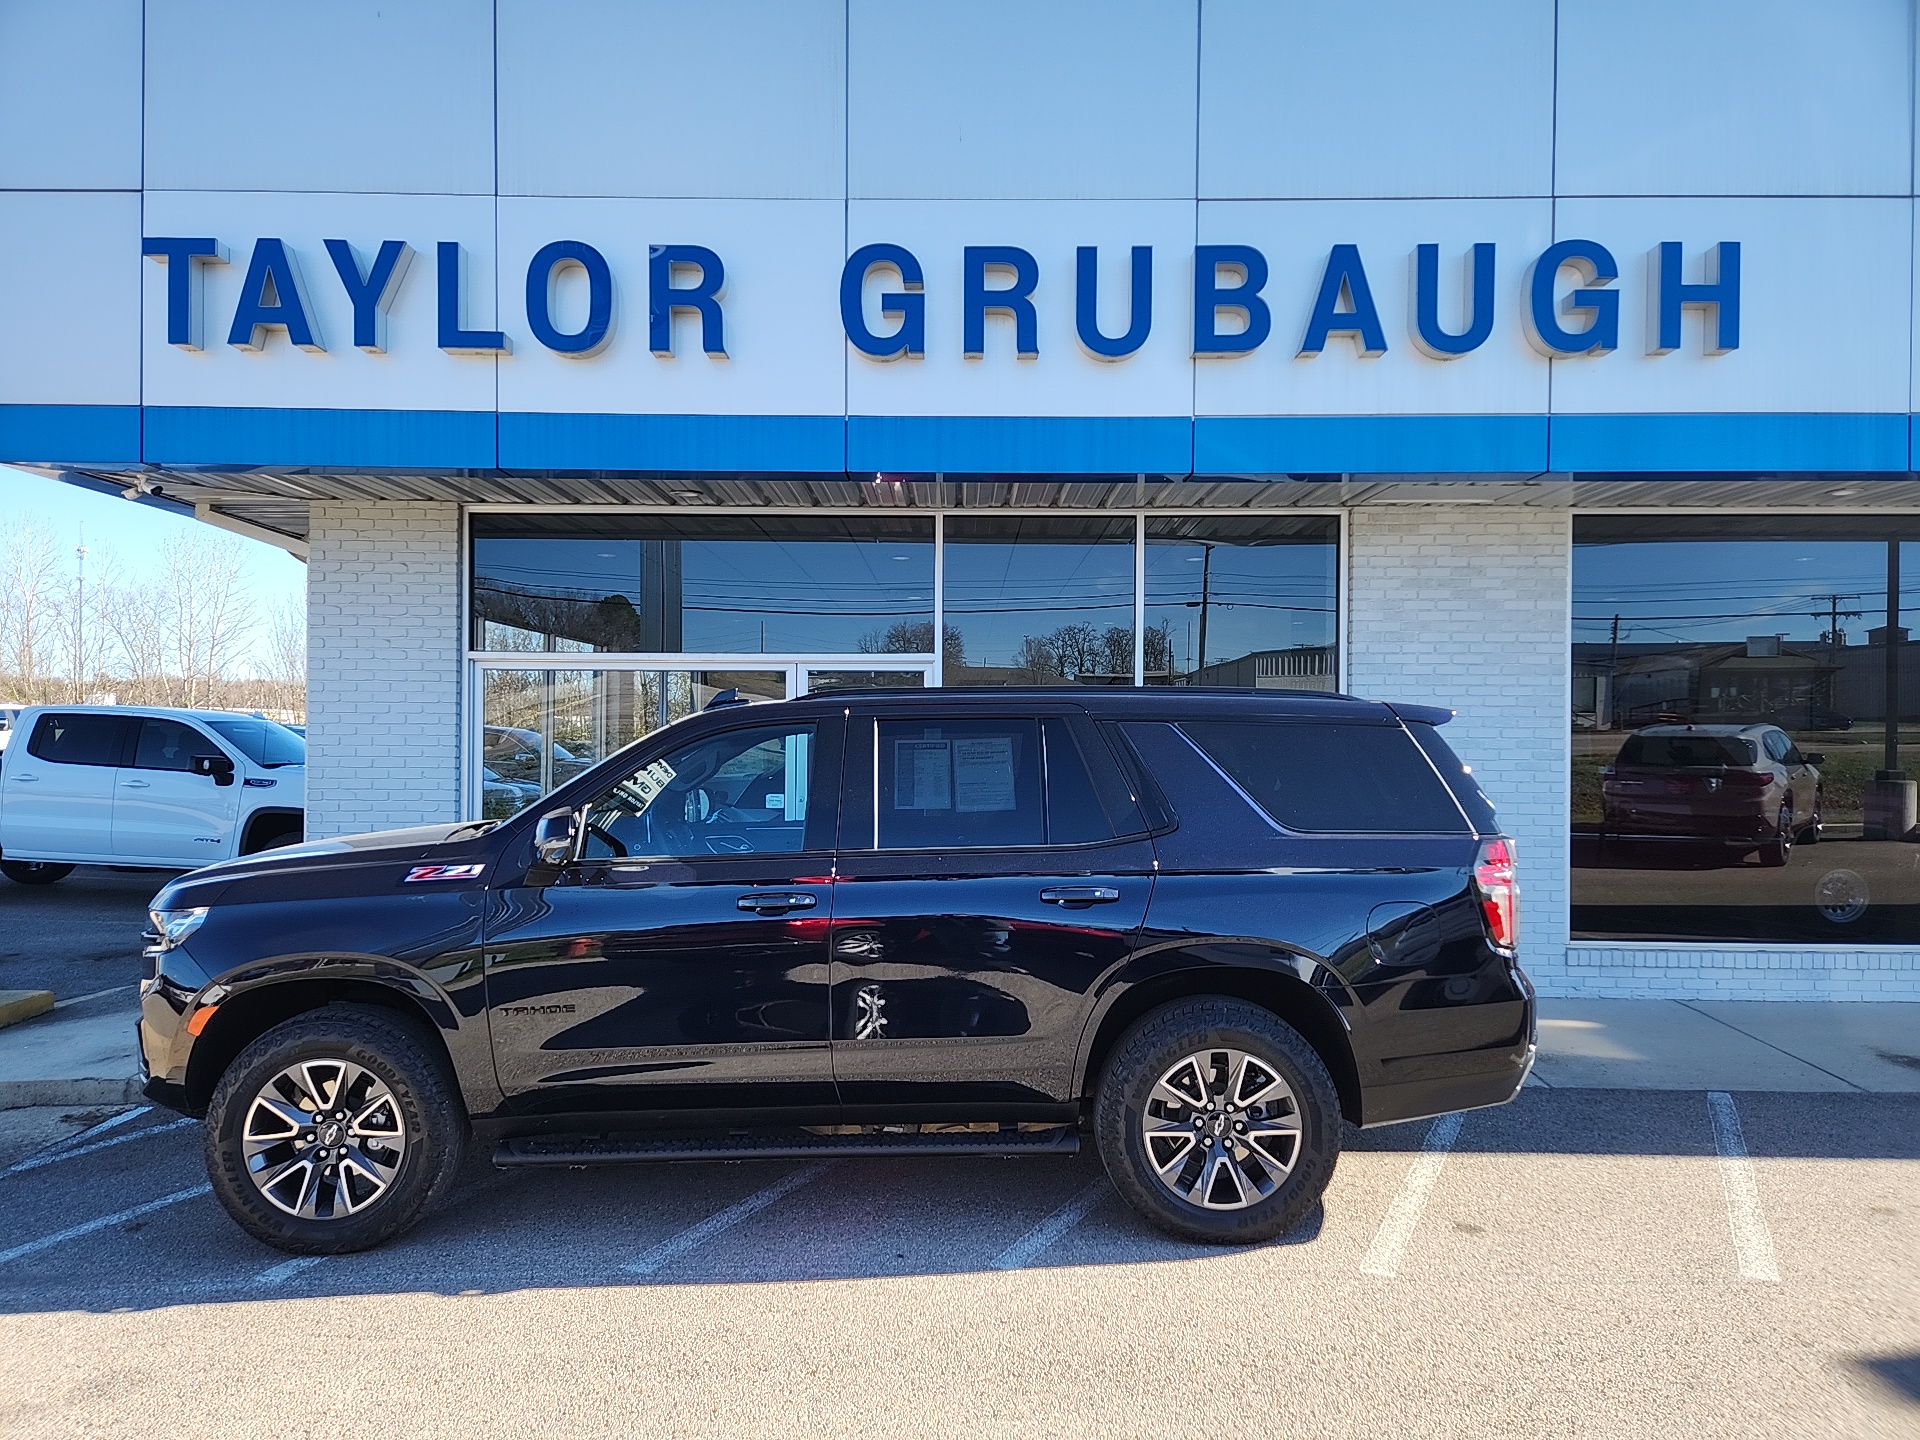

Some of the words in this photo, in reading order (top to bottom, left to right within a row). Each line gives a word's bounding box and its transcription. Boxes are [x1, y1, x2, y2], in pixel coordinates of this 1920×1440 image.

[142, 237, 729, 359] TAYLOR
[840, 239, 1742, 362] GRUBAUGH
[500, 1004, 576, 1017] TAHOE
[1131, 1033, 1208, 1100] WRANGLER
[220, 1150, 286, 1235] WRANGLER
